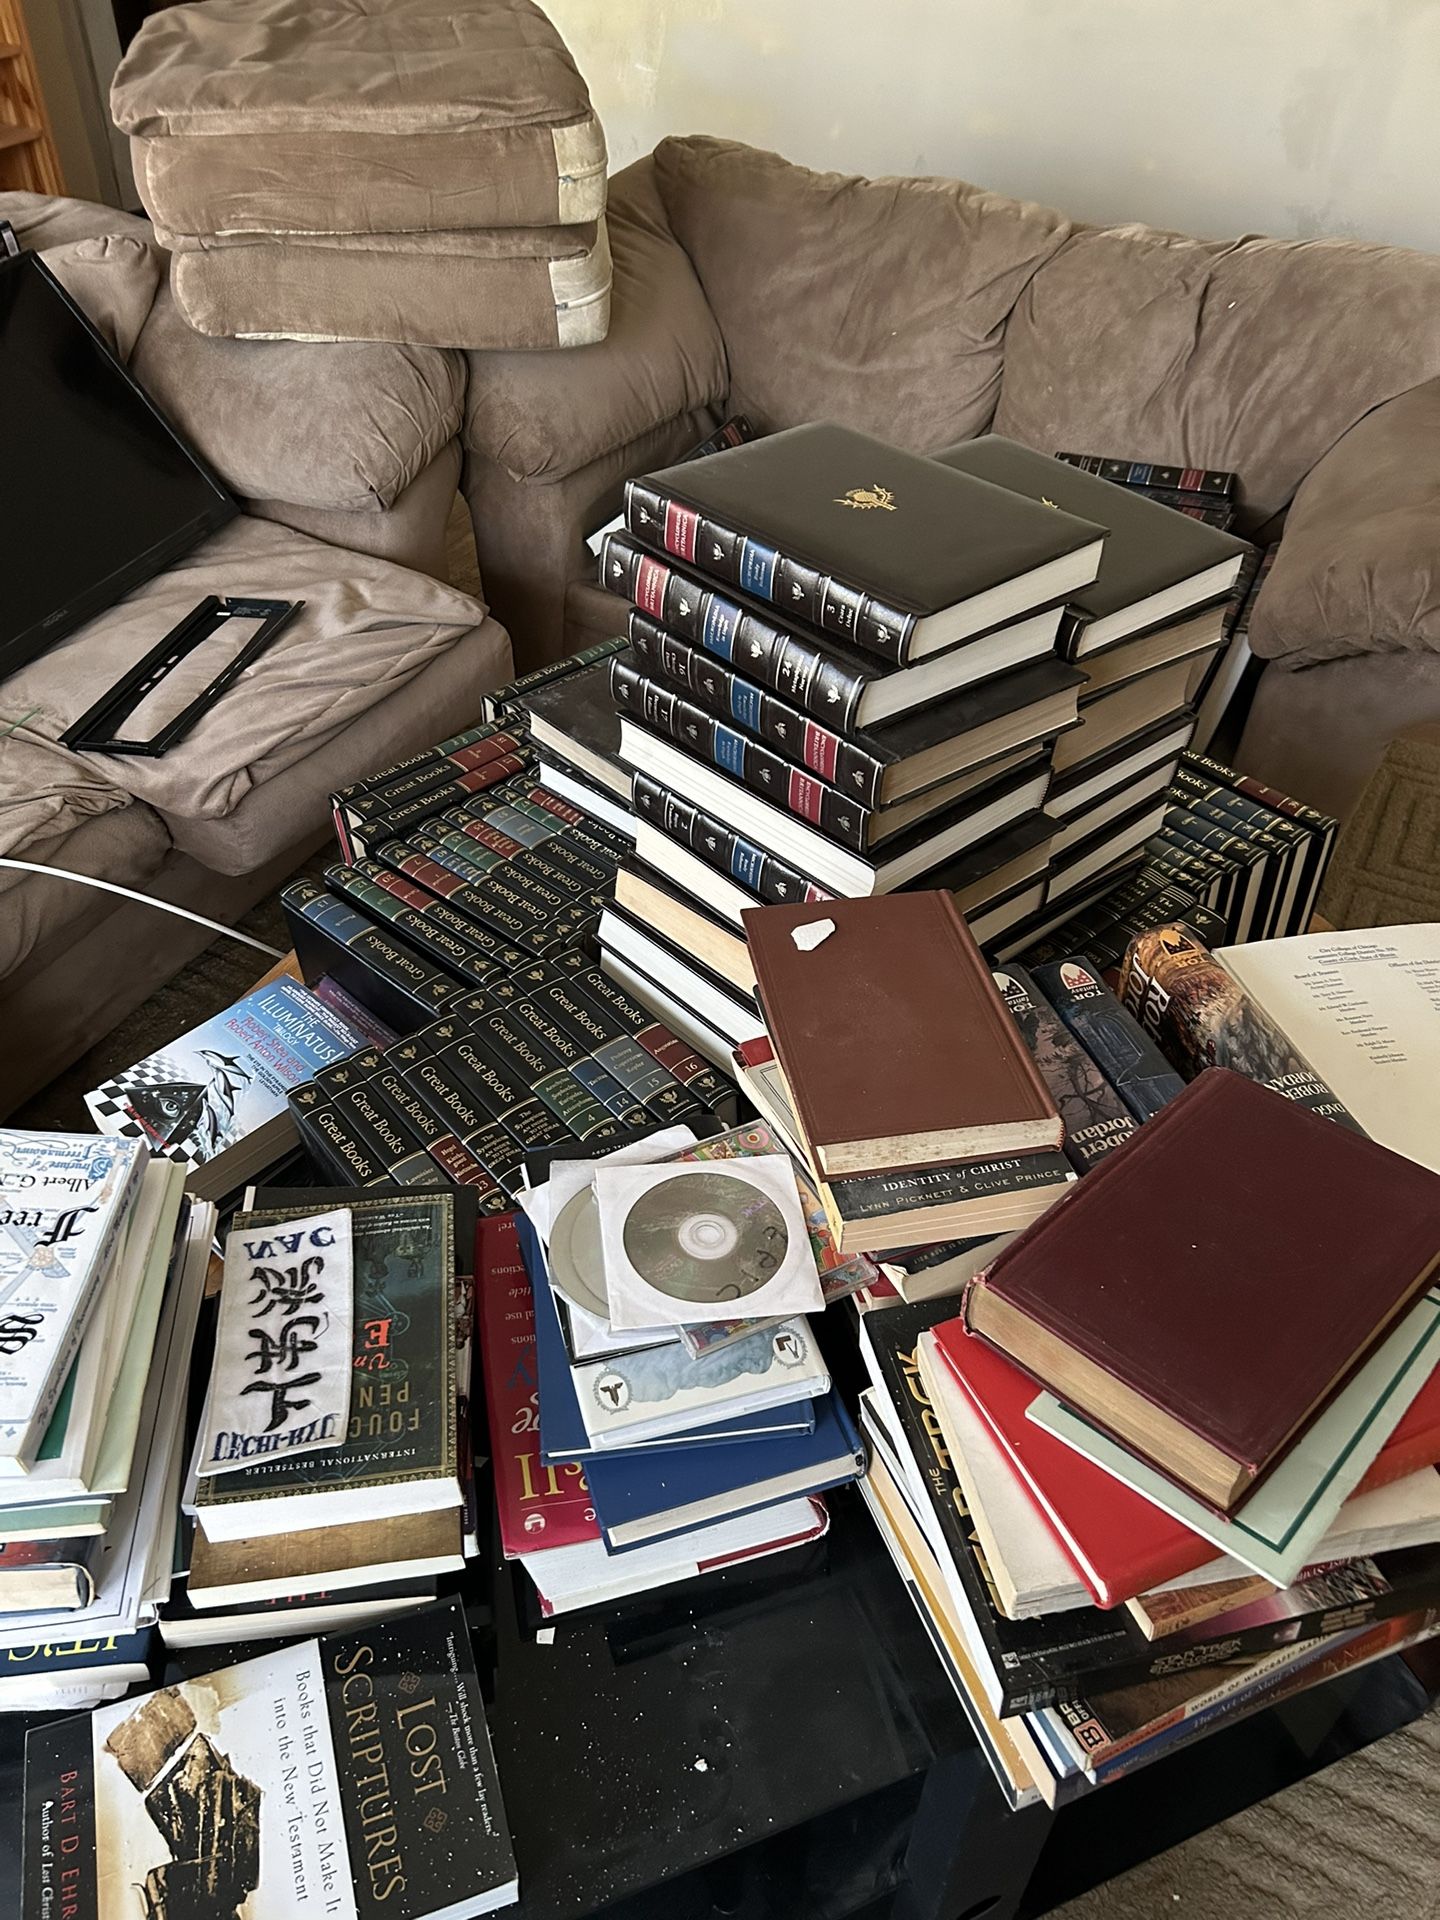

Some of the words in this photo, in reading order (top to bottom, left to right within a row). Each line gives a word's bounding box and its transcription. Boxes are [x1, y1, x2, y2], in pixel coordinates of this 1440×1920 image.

[827, 604, 836, 614] 3
[514, 673, 541, 687] Great
[679, 663, 686, 675] 16
[782, 661, 793, 678] 24
[660, 709, 668, 722] 17
[366, 767, 396, 783] Great
[398, 749, 435, 771] Books
[1200, 755, 1236, 778] Books
[384, 780, 416, 798] Great
[416, 763, 451, 784] Books
[388, 803, 420, 823] Great
[420, 785, 456, 806] Books
[569, 828, 600, 850] Books
[522, 852, 554, 876] Books
[547, 841, 581, 863] Books
[500, 865, 535, 889] Books
[551, 869, 582, 893] Great
[576, 857, 606, 880] Great
[462, 889, 495, 914] Books
[487, 880, 521, 904] Books
[532, 883, 562, 906] Great
[1160, 896, 1175, 909] The
[433, 905, 469, 931] Books
[491, 907, 523, 931] Great
[518, 900, 548, 921] Great
[1146, 900, 1169, 918] Great
[405, 913, 440, 942] Books
[464, 925, 497, 948] Great
[365, 935, 400, 963] Books
[435, 936, 466, 958] Great
[395, 956, 426, 981] Great
[587, 972, 612, 999] Great
[611, 995, 645, 1026] Books
[1007, 996, 1030, 1006] fanta
[1072, 990, 1105, 1002] TOR
[301, 1012, 321, 1028] THE
[549, 987, 574, 1016] Great
[574, 1009, 607, 1041] Books
[241, 1015, 271, 1041] Robert
[258, 994, 345, 1064] ILLUMINATUS!
[273, 1022, 301, 1046] TRILOGY
[518, 1002, 544, 1032] Great
[543, 1027, 577, 1058] Books
[224, 1018, 253, 1042] Robert
[249, 1040, 276, 1062] Anton
[273, 1060, 301, 1085] Wilson
[489, 1017, 517, 1050] Great
[513, 1043, 547, 1073] Books
[457, 1044, 482, 1073] Great
[482, 1070, 515, 1103] Books
[684, 1060, 698, 1073] 16
[646, 1076, 661, 1088] 15
[381, 1074, 407, 1105] Great
[405, 1100, 439, 1136] Books
[419, 1065, 445, 1096] Great
[445, 1093, 478, 1127] Books
[615, 1097, 630, 1109] 14
[350, 1090, 379, 1123] Great
[373, 1118, 405, 1155] Books
[519, 1110, 532, 1118] The
[587, 1112, 596, 1122] 4
[1070, 1116, 1134, 1144] Jordan
[318, 1112, 347, 1145] Great
[341, 1141, 373, 1177] Books
[16, 1175, 36, 1189] G.
[43, 1177, 97, 1193] Albert
[882, 1171, 951, 1192] IDENTITY
[956, 1167, 967, 1179] of
[970, 1158, 1022, 1177] CHRIST
[859, 1200, 890, 1213] LYNN
[895, 1187, 953, 1205] PICKNETT
[959, 1184, 970, 1194] &
[974, 1178, 1010, 1191] CLIVE
[1015, 1169, 1062, 1183] PRINCE
[504, 1312, 522, 1321] use
[358, 1381, 411, 1408] PEN
[244, 1459, 316, 1476] BESTSELLER
[321, 1447, 416, 1467] INTERNATIONAL
[928, 1467, 947, 1496] THE
[1154, 1648, 1195, 1666] STAR
[296, 1669, 315, 1720] Books
[1191, 1689, 1225, 1712] WORLD
[1228, 1681, 1241, 1692] OF
[274, 1697, 286, 1730] into
[459, 1699, 470, 1725] shock
[303, 1725, 317, 1757] that
[396, 1697, 447, 1796] LOST
[452, 1726, 462, 1749] Boston
[457, 1749, 467, 1770] Globe
[464, 1725, 474, 1746] more
[278, 1735, 292, 1762] the
[468, 1747, 479, 1766] than
[282, 1765, 299, 1806] New
[307, 1760, 326, 1795] Did
[334, 1645, 406, 1901] SCRIPTURES
[474, 1773, 484, 1790] few
[61, 1770, 78, 1824] BART
[476, 1790, 486, 1801] lay
[41, 1800, 54, 1840] Author
[312, 1799, 328, 1835] Not
[41, 1843, 53, 1860] of
[61, 1835, 80, 1861] D.
[287, 1811, 308, 1903] Testament
[42, 1864, 54, 1884] Lost
[318, 1841, 337, 1892] Make
[41, 1887, 55, 1920] Christ
[61, 1867, 80, 1920] EHR
[326, 1897, 341, 1914] It
